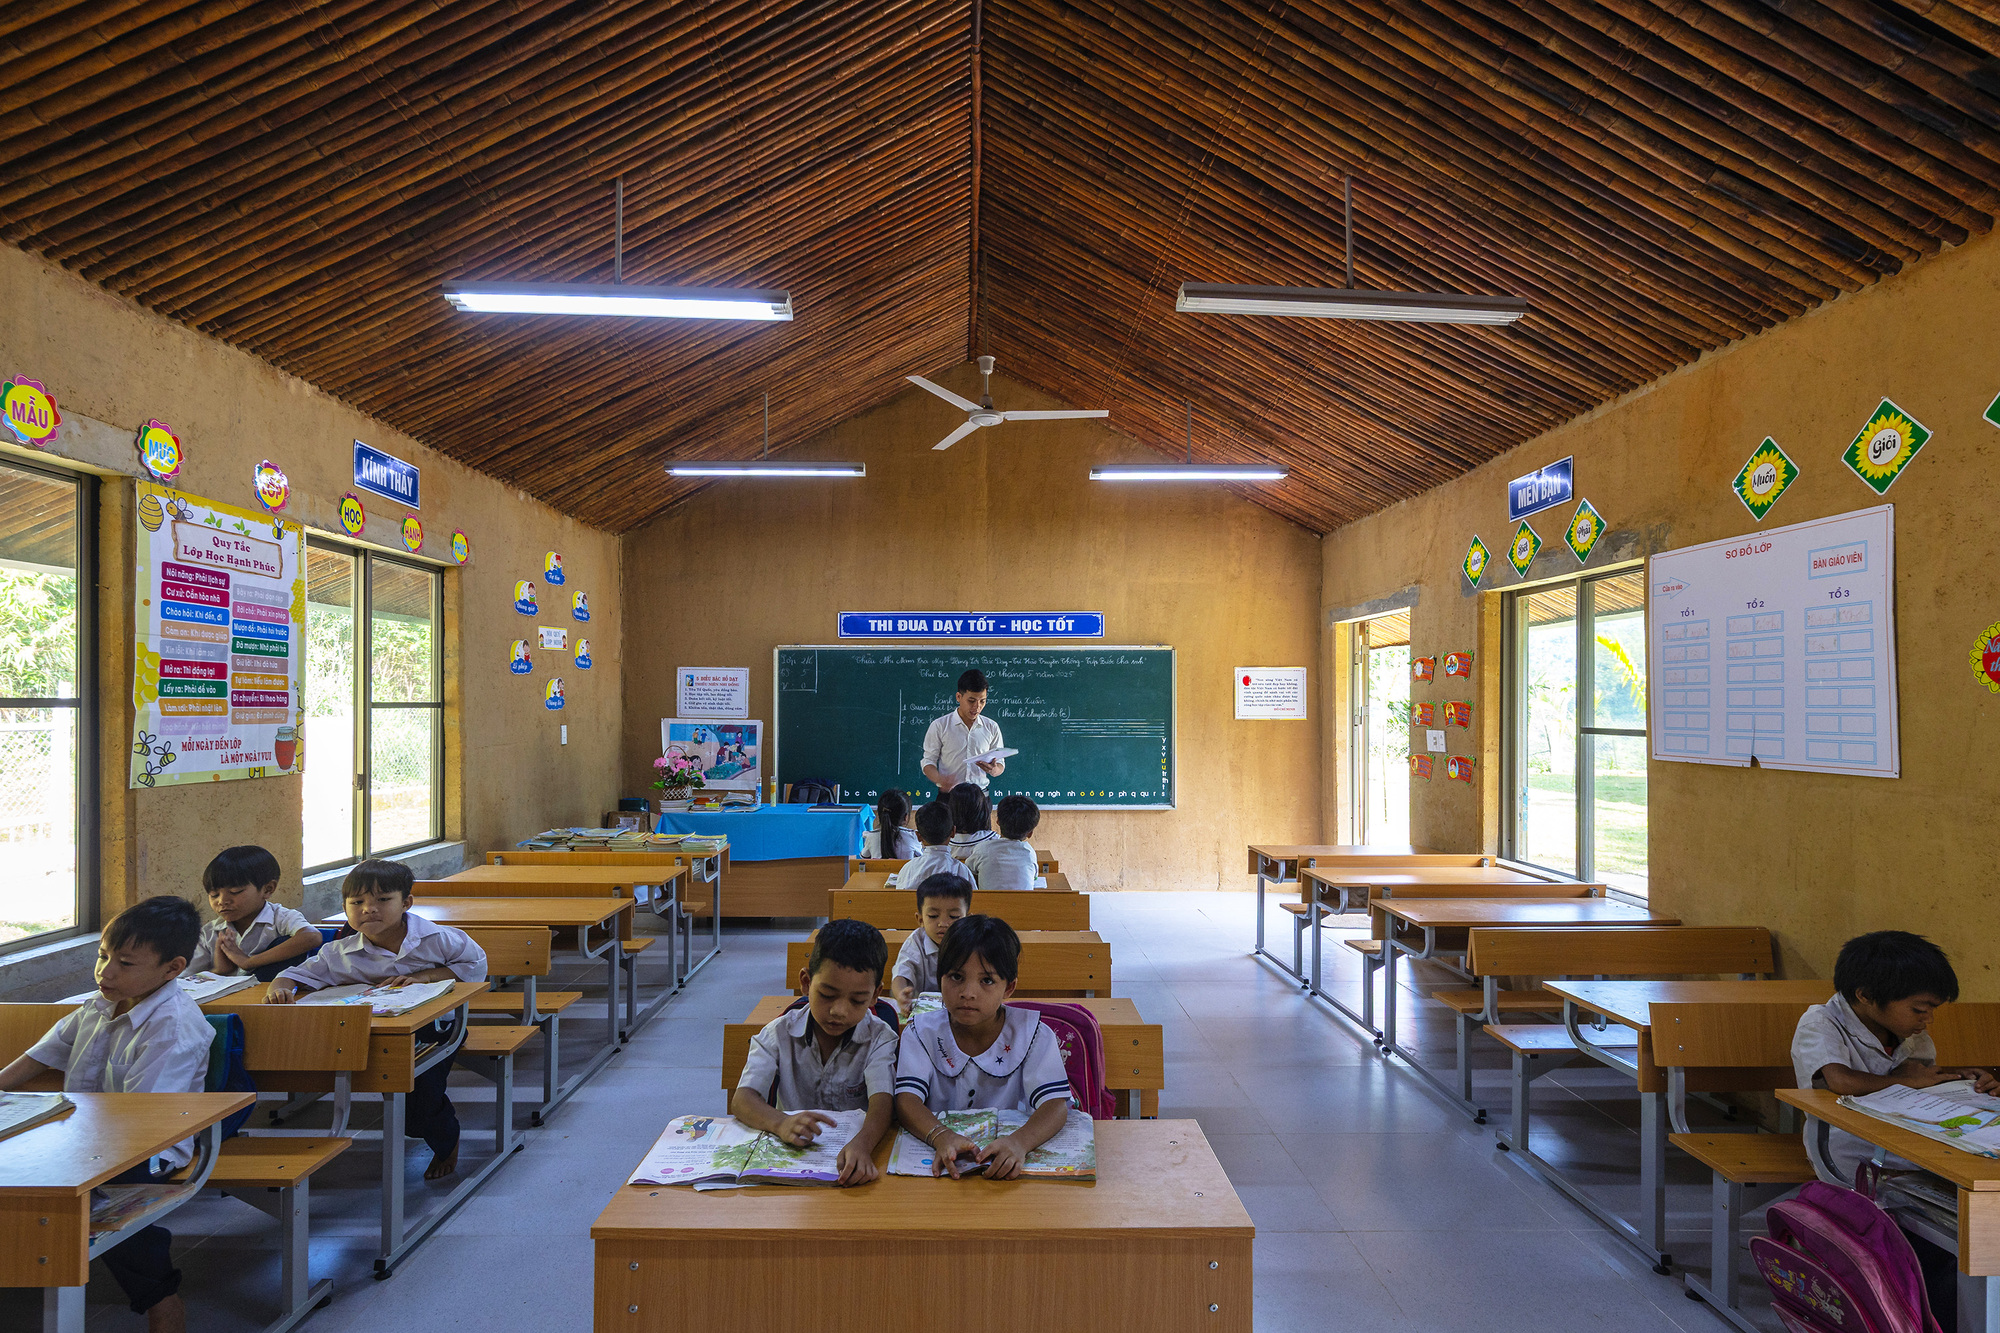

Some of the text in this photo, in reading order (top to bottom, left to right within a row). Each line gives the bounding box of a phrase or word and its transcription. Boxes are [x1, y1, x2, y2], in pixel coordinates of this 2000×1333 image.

[12, 396, 48, 429] MẪU
[148, 438, 176, 467] MỰC
[1872, 434, 1896, 460] Giỏi
[362, 456, 413, 497] KÍNH THẦY
[1752, 468, 1776, 489] Muốn
[1541, 473, 1560, 502] BẠN
[344, 506, 362, 528] HỌC
[404, 525, 422, 544] HẠNH
[212, 536, 250, 552] Quy Tắc
[1725, 542, 1772, 559] SƠ ĐỒ LỚP
[183, 545, 276, 572] Lớp Học Hạnh Phúc
[1813, 551, 1863, 569] BÀN GIÁO VIÊN
[1828, 587, 1850, 599] TỔ 3
[1681, 607, 1690, 617] TỔ
[1746, 598, 1758, 609] TỔ
[868, 620, 892, 632] THI
[897, 620, 928, 632] ĐUA
[933, 620, 963, 634] DẠY
[968, 616, 996, 632] TỐT
[1011, 620, 1042, 634] HỌC
[1047, 616, 1075, 632] TỐT
[181, 736, 242, 751] MỖI NGÀY ĐẾN LỚP
[220, 752, 230, 764] LÀ
[230, 751, 243, 765] MỘT
[261, 752, 272, 761] VUI
